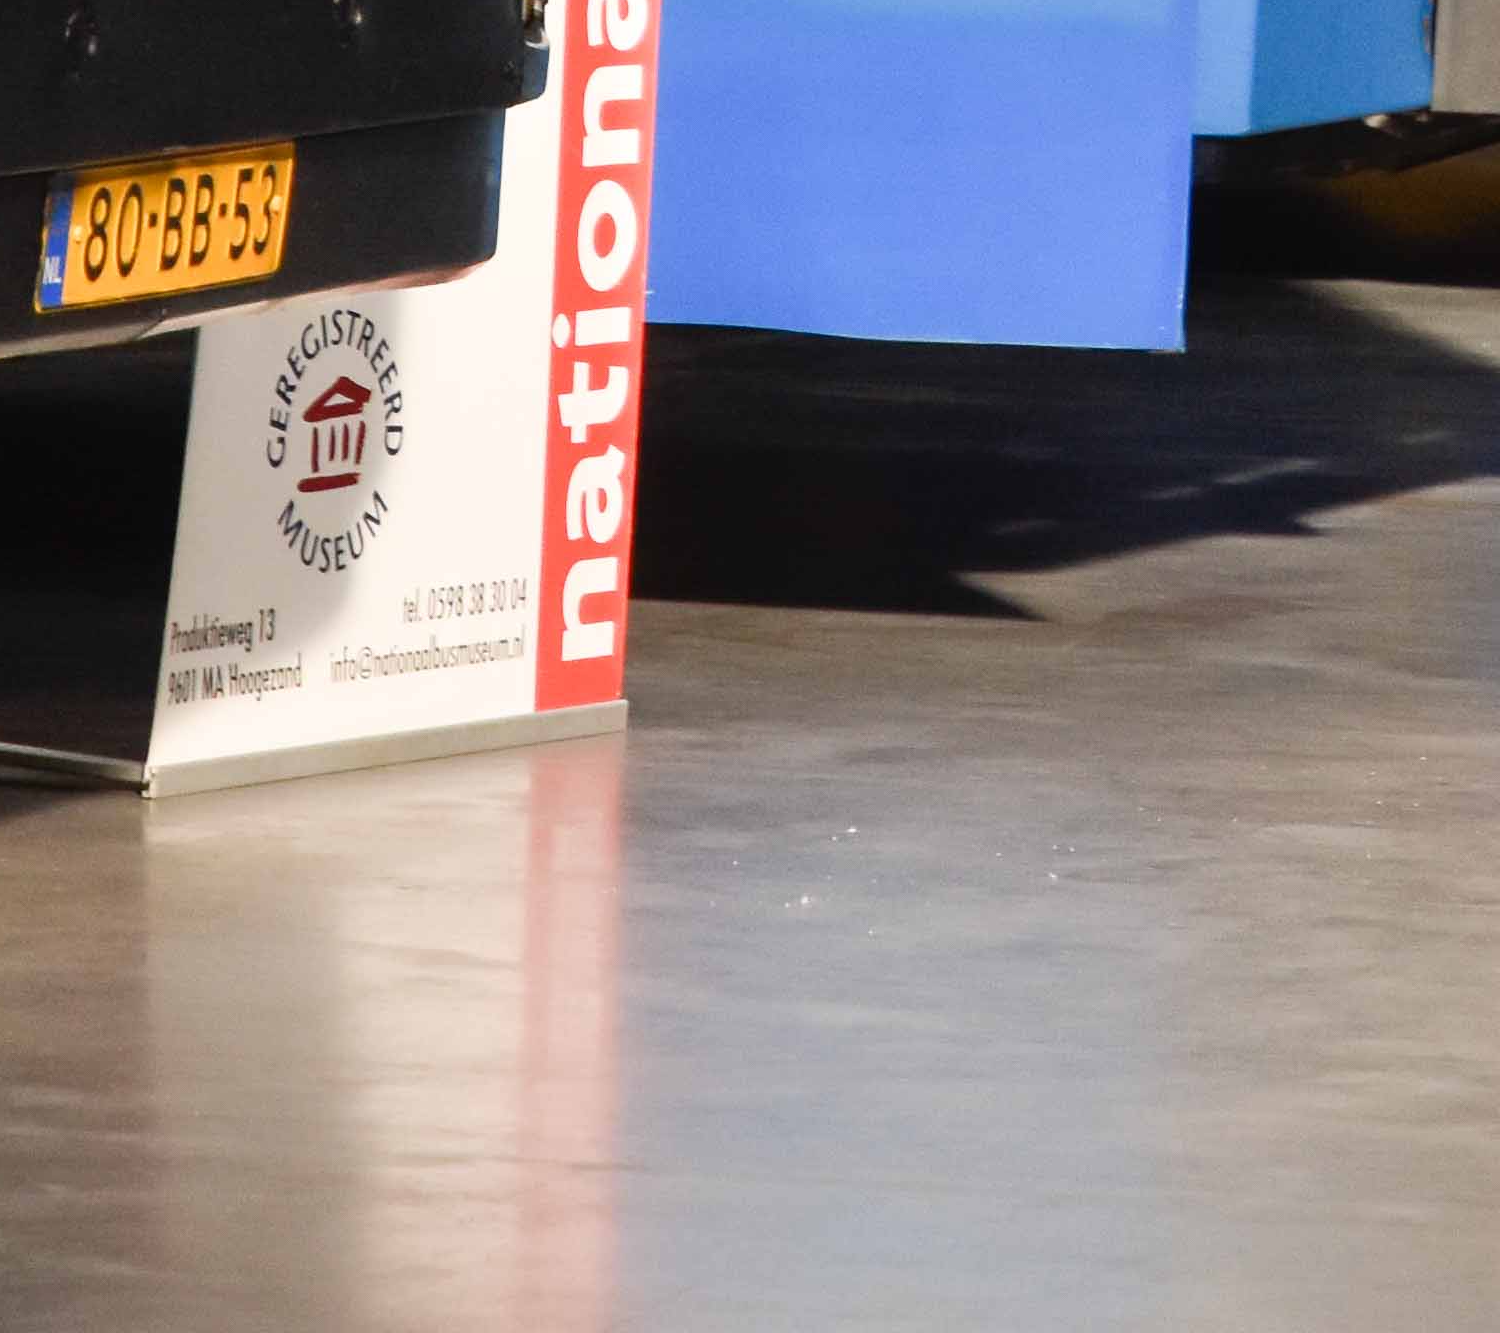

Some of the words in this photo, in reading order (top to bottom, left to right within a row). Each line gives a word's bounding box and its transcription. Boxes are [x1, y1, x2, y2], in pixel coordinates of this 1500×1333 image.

[83, 164, 278, 282] 80-BB-53
[42, 256, 63, 285] NL
[266, 308, 404, 469] GEREGISTREERD
[276, 489, 389, 574] MUSEUM
[258, 607, 276, 644] 13
[167, 668, 197, 706] 9601
[201, 664, 225, 700] MA
[228, 652, 302, 702] Hoogezand
